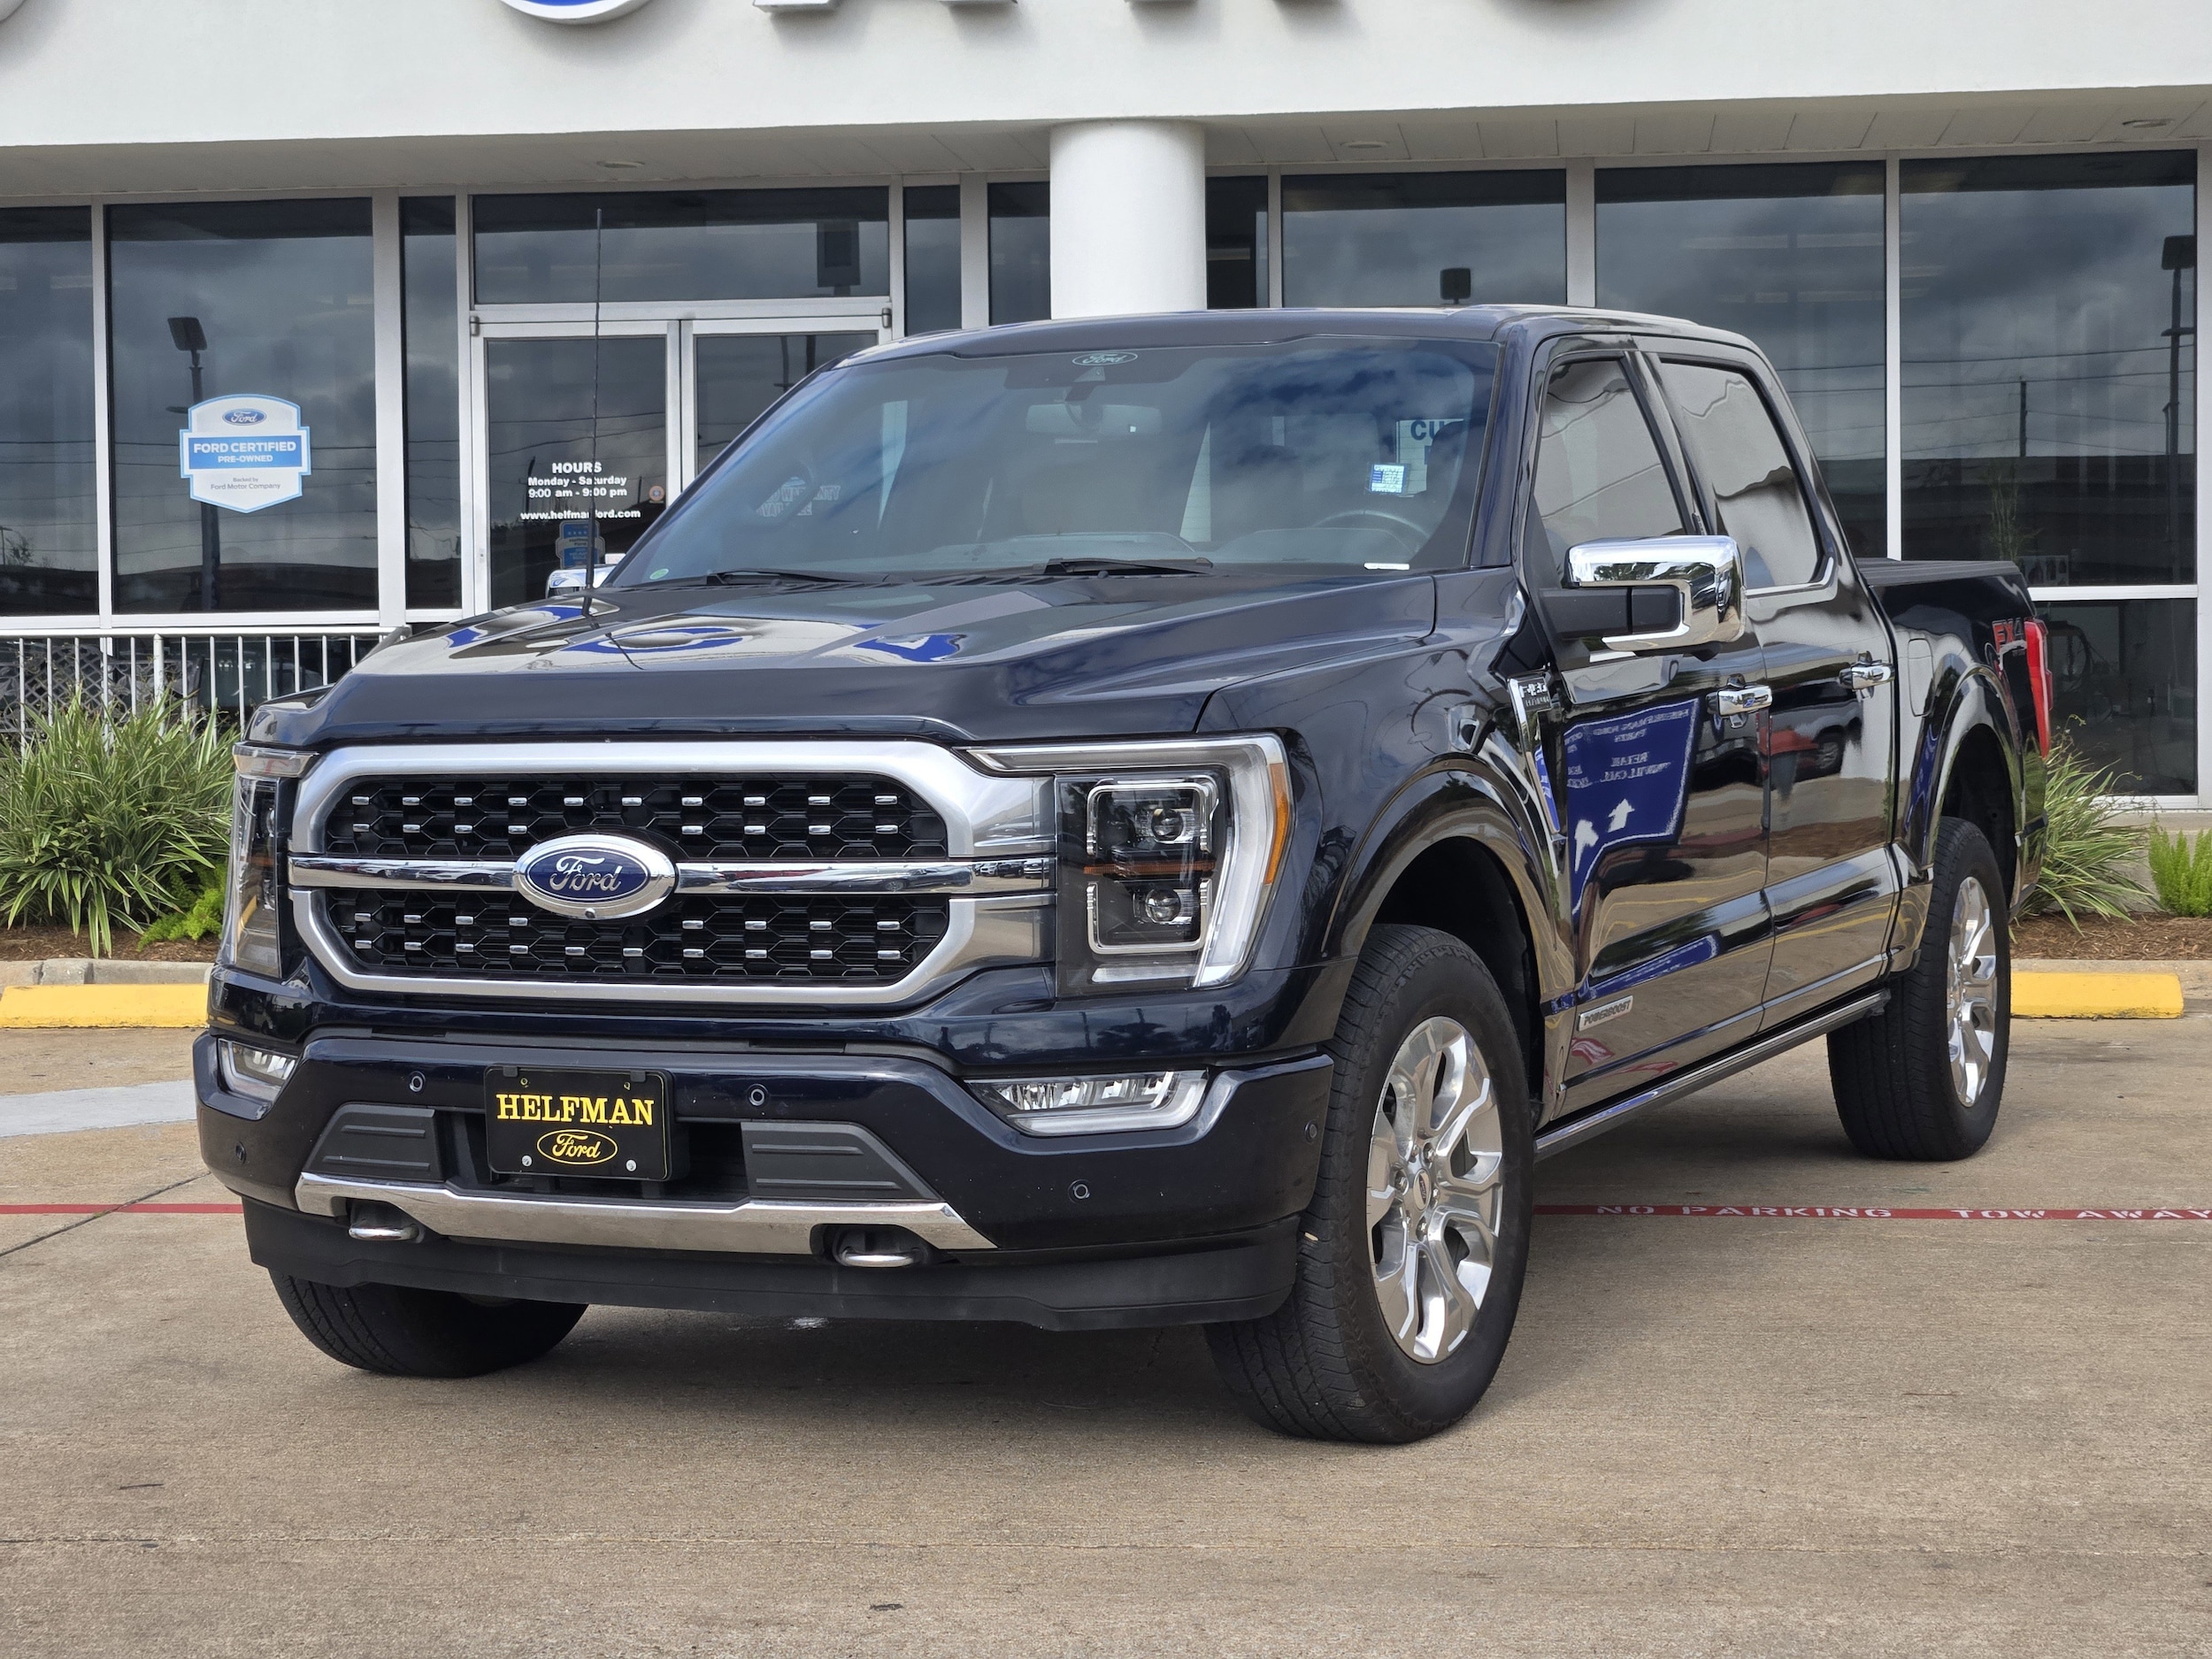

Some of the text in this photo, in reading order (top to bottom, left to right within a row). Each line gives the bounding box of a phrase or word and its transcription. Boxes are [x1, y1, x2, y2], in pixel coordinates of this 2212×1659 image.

[1082, 353, 1128, 364] Ford
[231, 411, 257, 423] Ford
[194, 441, 296, 453] FORD CERTIFIED
[551, 462, 603, 473] HOURS
[528, 477, 569, 488] Monday
[528, 488, 551, 498] 9:00
[582, 487, 607, 496] 9:00
[610, 488, 627, 498] pm
[520, 510, 641, 520] www.helfmaord.com
[549, 856, 623, 892] Ford
[495, 1094, 655, 1125] HELFMAN
[552, 1133, 602, 1159] Ford
[1596, 1205, 2212, 1219] NO PARKING TOW AWAY
